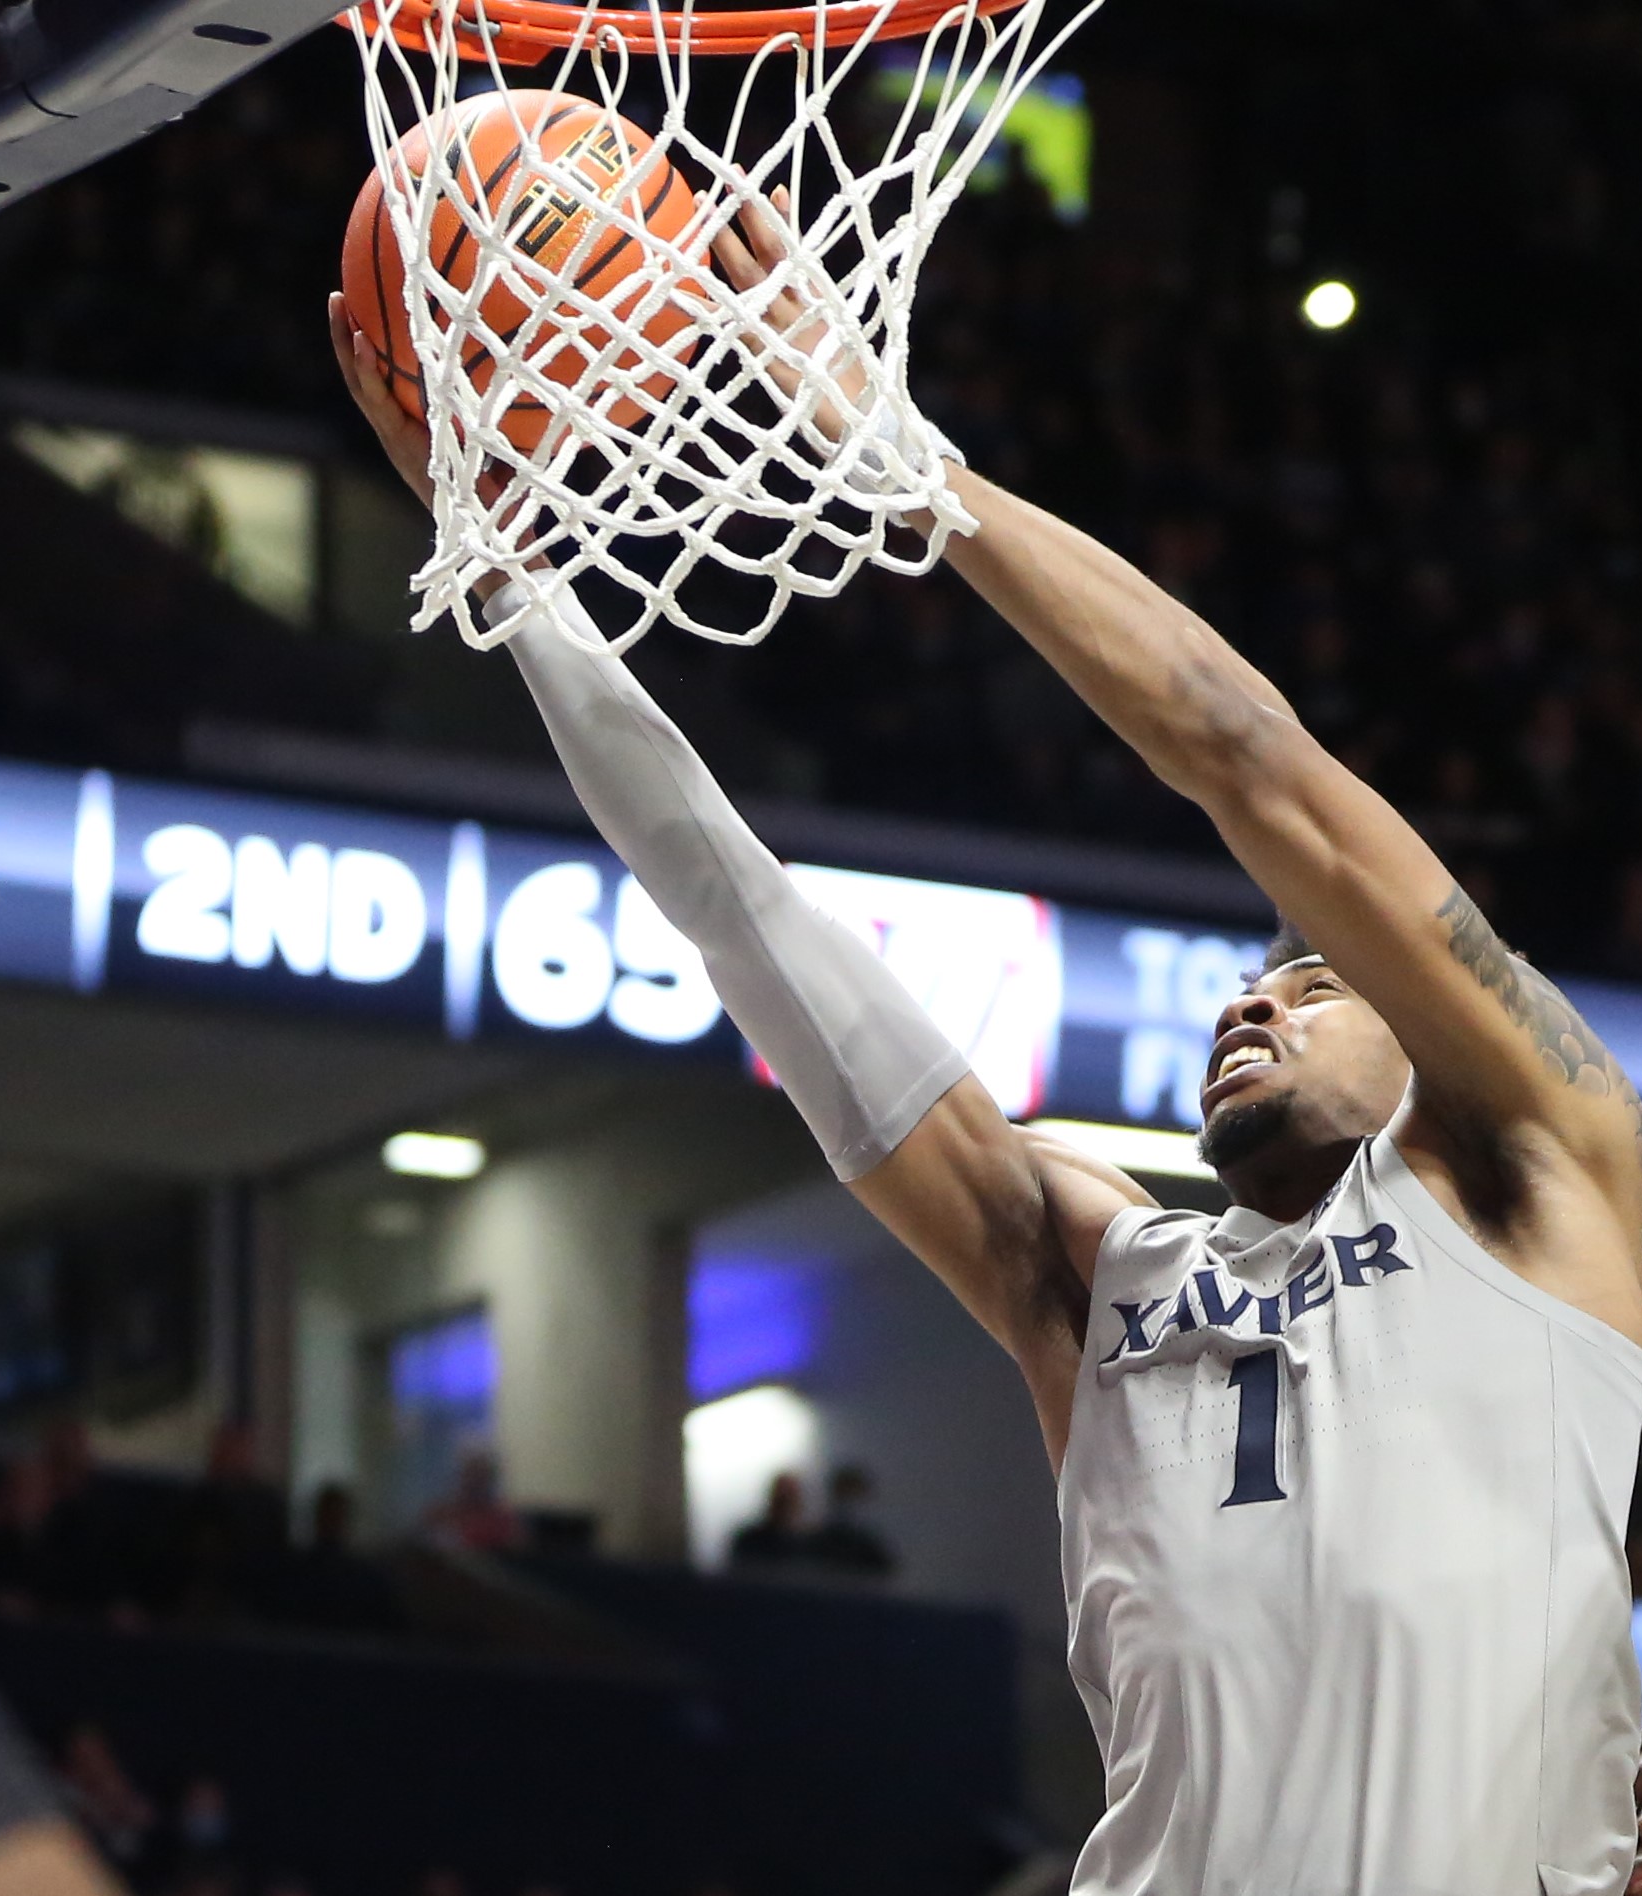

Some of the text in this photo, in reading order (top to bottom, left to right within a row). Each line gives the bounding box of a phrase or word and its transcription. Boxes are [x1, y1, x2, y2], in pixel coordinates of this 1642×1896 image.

[137, 823, 427, 983] 2ND
[492, 861, 723, 1044] 65
[1097, 1222, 1414, 1365] XAVIER
[1219, 1349, 1288, 1510] 1
